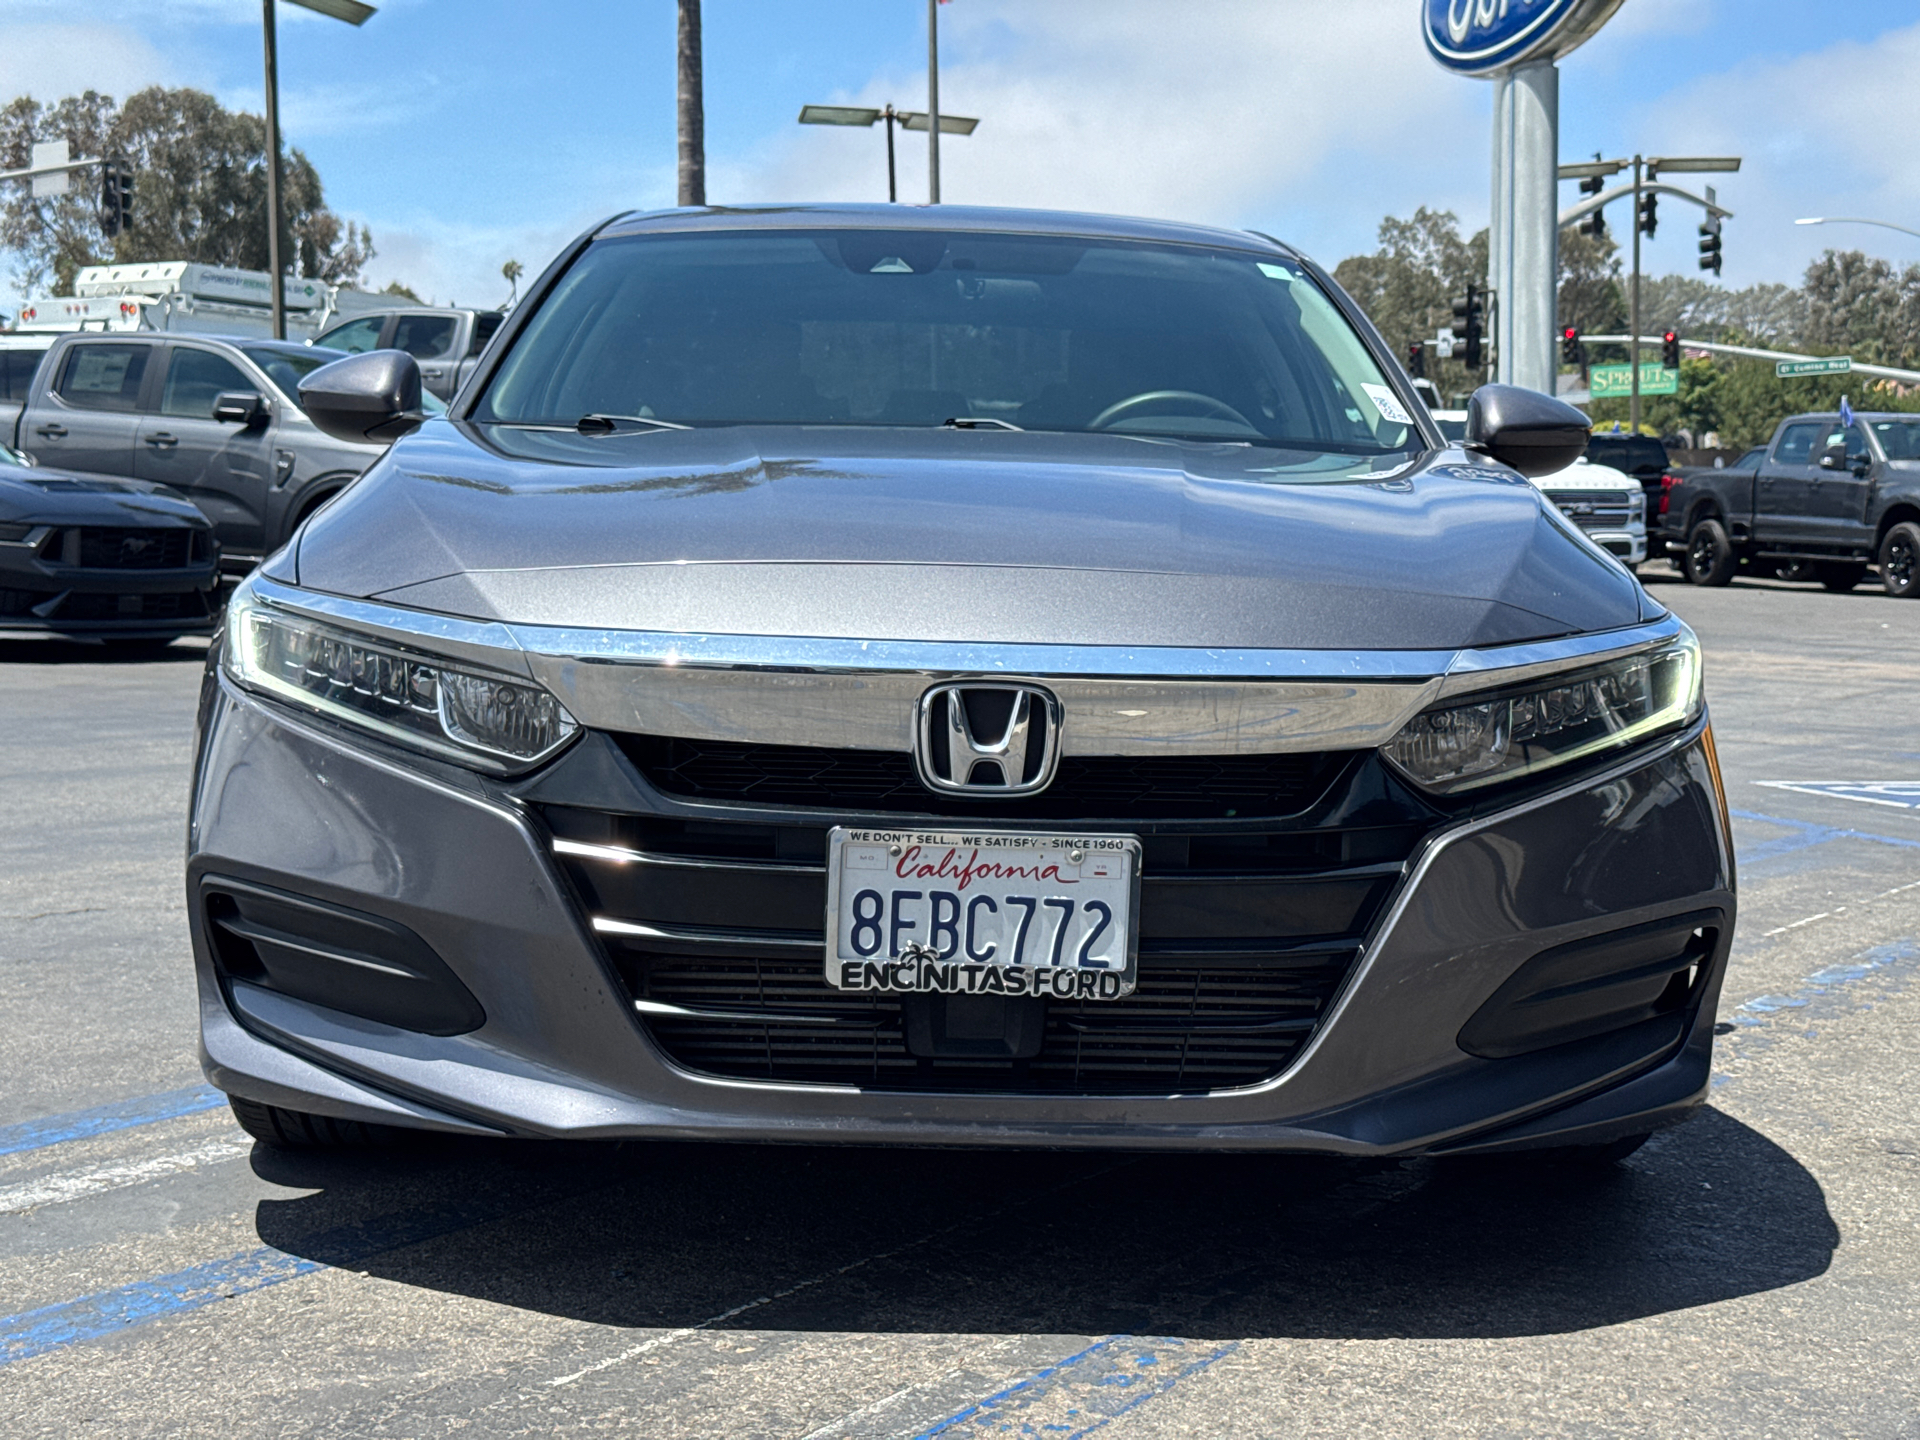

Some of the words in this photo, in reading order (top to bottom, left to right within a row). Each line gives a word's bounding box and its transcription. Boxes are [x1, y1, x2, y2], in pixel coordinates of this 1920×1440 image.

[1591, 367, 1677, 392] SPRUTS
[850, 831, 870, 841] WE
[873, 832, 913, 844] DON'T
[916, 834, 958, 845] SELL...
[962, 836, 982, 846] WE
[985, 837, 1038, 848] SATISFY
[1051, 838, 1090, 849] SINCE
[1093, 839, 1123, 850] 1960
[896, 845, 1080, 891] California
[840, 962, 1027, 991] ENCINITAS
[1033, 966, 1122, 999] FORD
